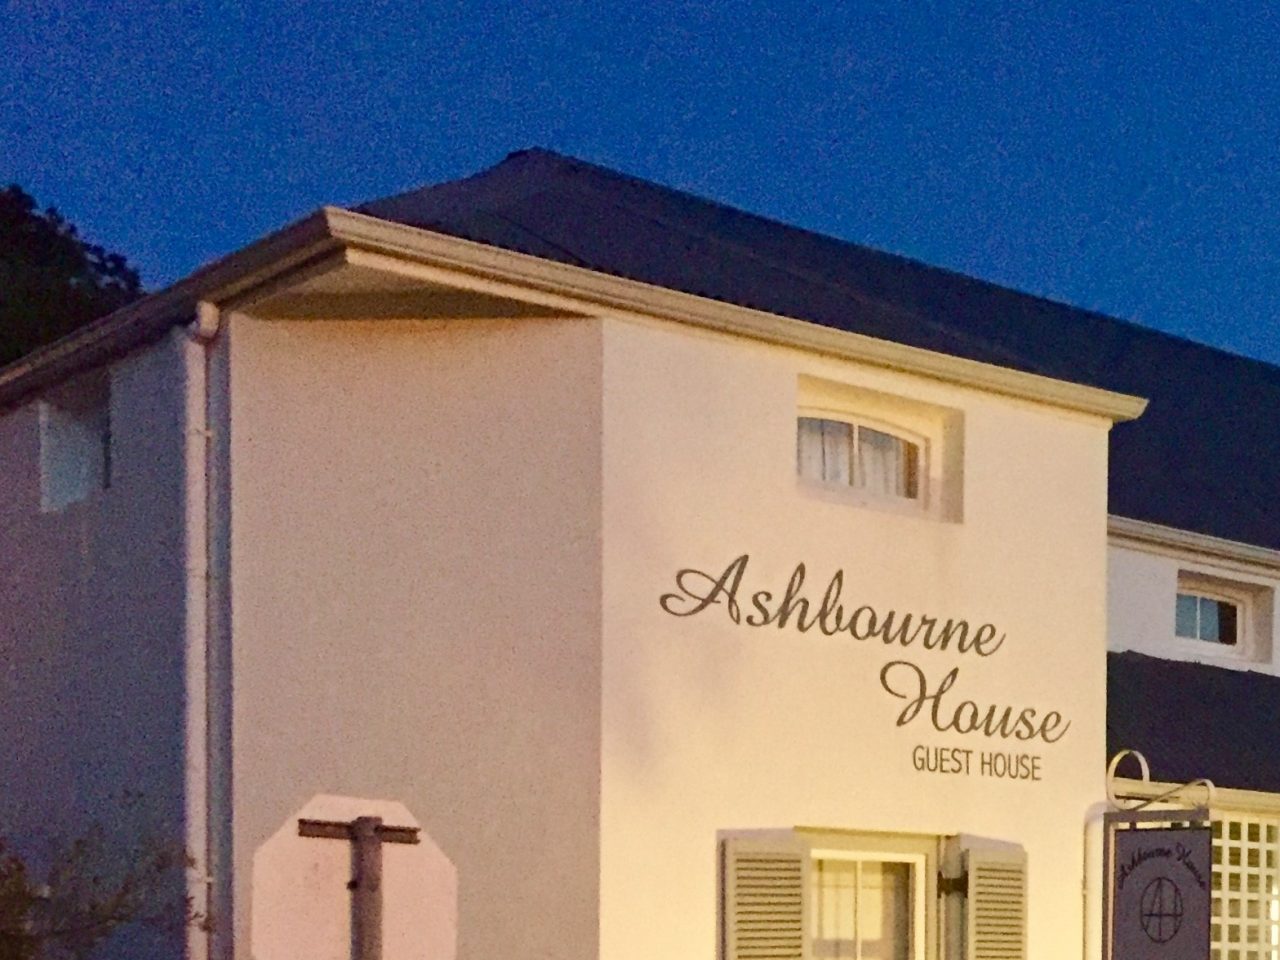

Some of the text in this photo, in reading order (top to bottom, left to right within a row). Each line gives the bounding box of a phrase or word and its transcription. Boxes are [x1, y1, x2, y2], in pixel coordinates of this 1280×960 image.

[660, 554, 1006, 657] Ashbourne
[880, 660, 1071, 744] House
[912, 745, 1042, 781] GUEST HOUSE
